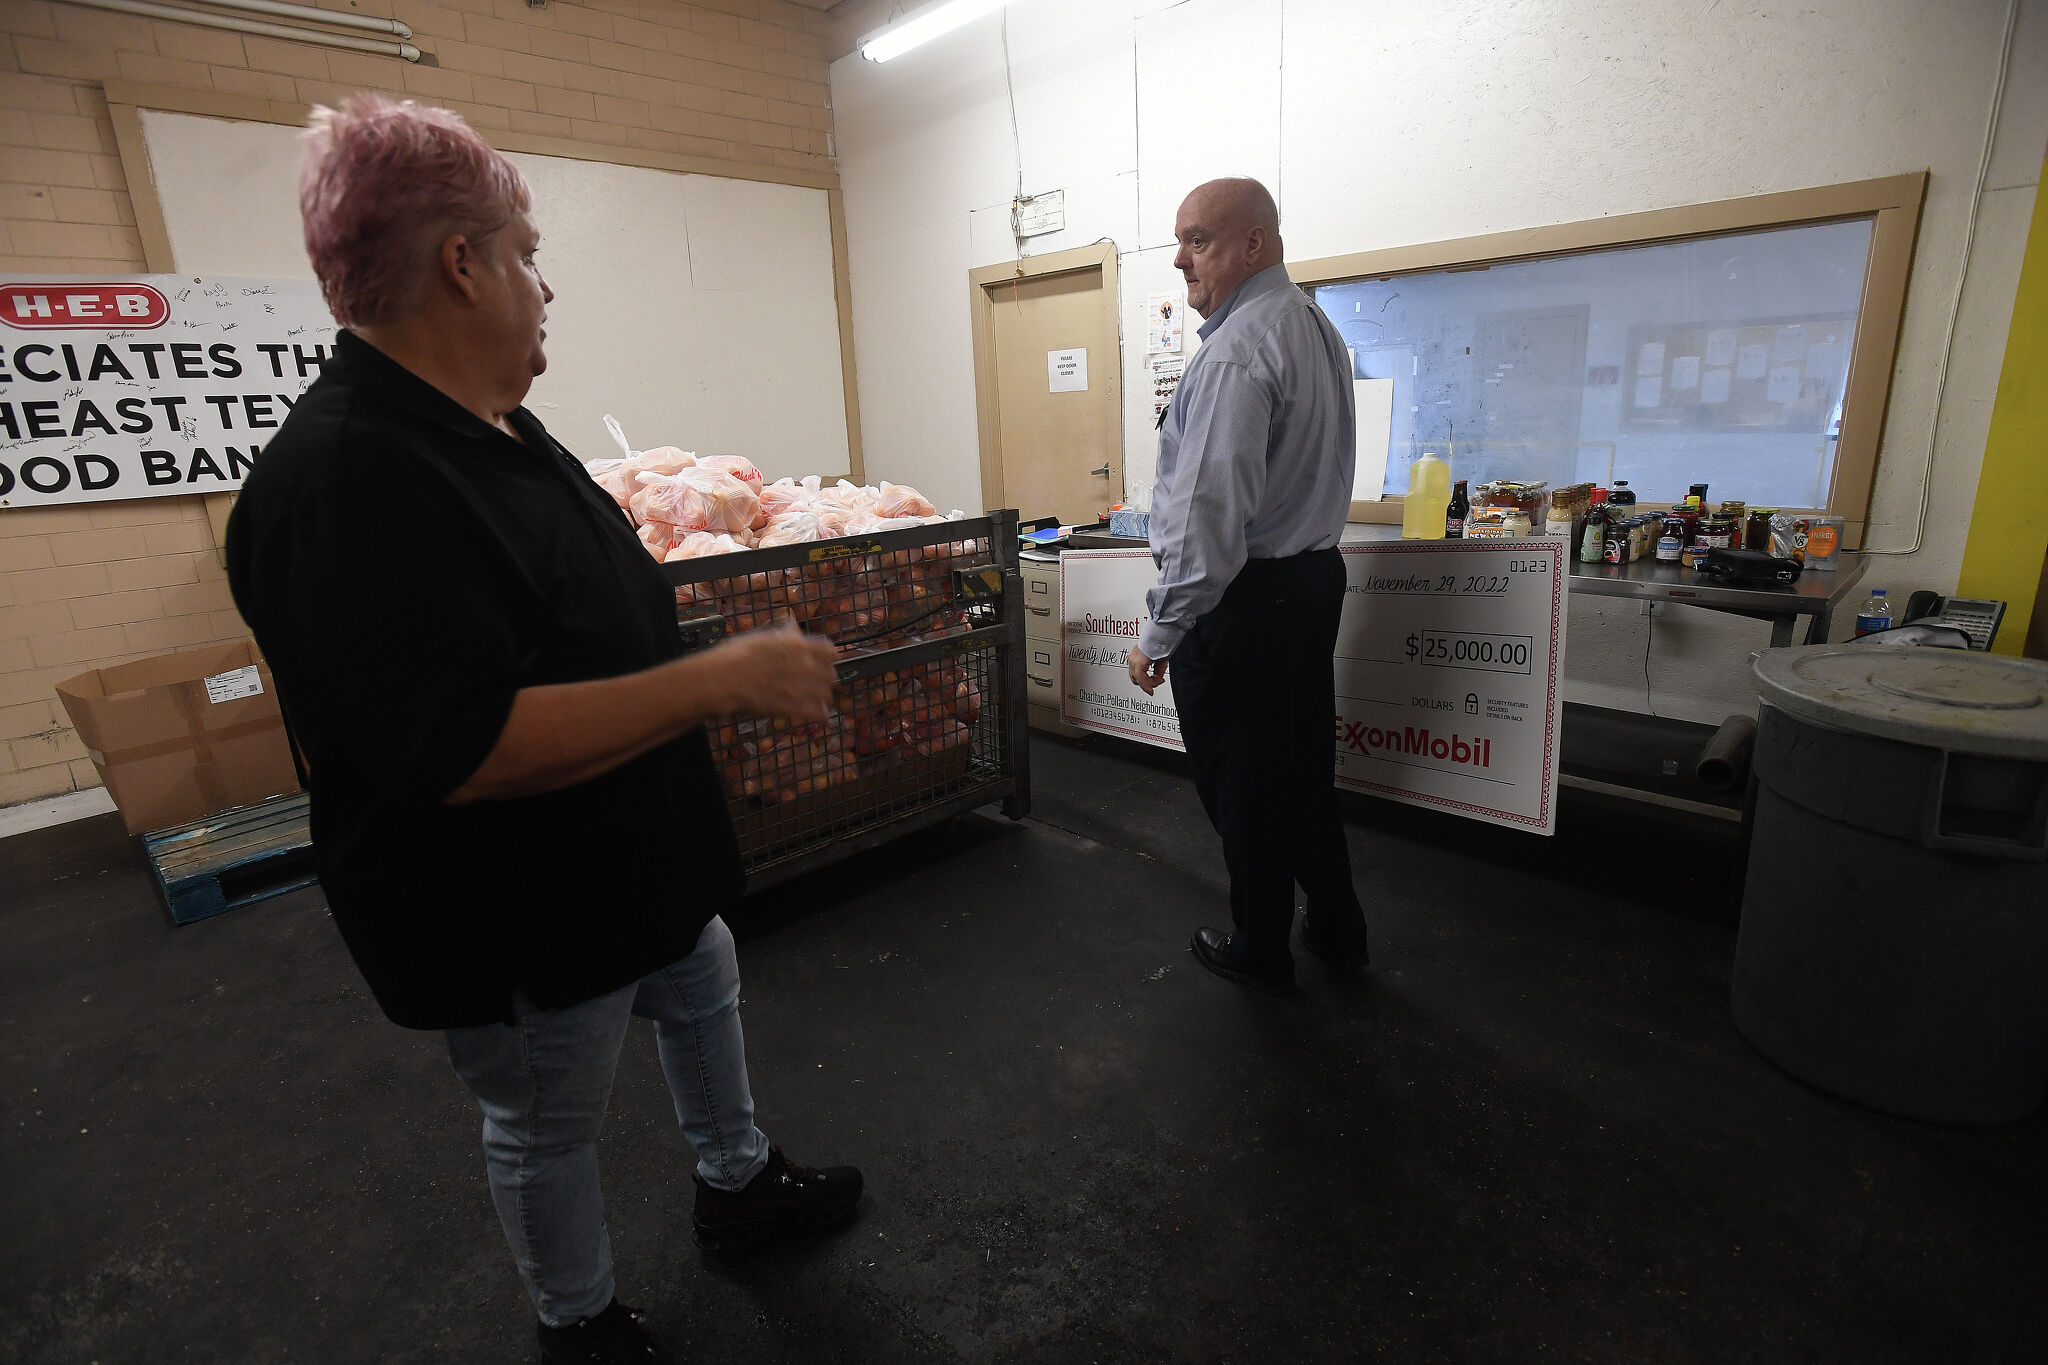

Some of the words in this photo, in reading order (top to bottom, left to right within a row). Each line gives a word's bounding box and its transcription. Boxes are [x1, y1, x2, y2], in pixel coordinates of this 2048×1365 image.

[12, 295, 151, 318] H-E-B
[256, 343, 338, 378] TH
[1510, 560, 1547, 573] 0123
[1361, 574, 1431, 592] November
[1435, 575, 1457, 594] 29,
[1463, 575, 1510, 593] 2022
[1085, 612, 1140, 637] Southeast
[1068, 643, 1098, 666] Twenty
[1099, 647, 1118, 667] five
[1405, 632, 1419, 661] $
[1424, 637, 1527, 666] 25,000.00
[1411, 697, 1454, 712] DOLLARS
